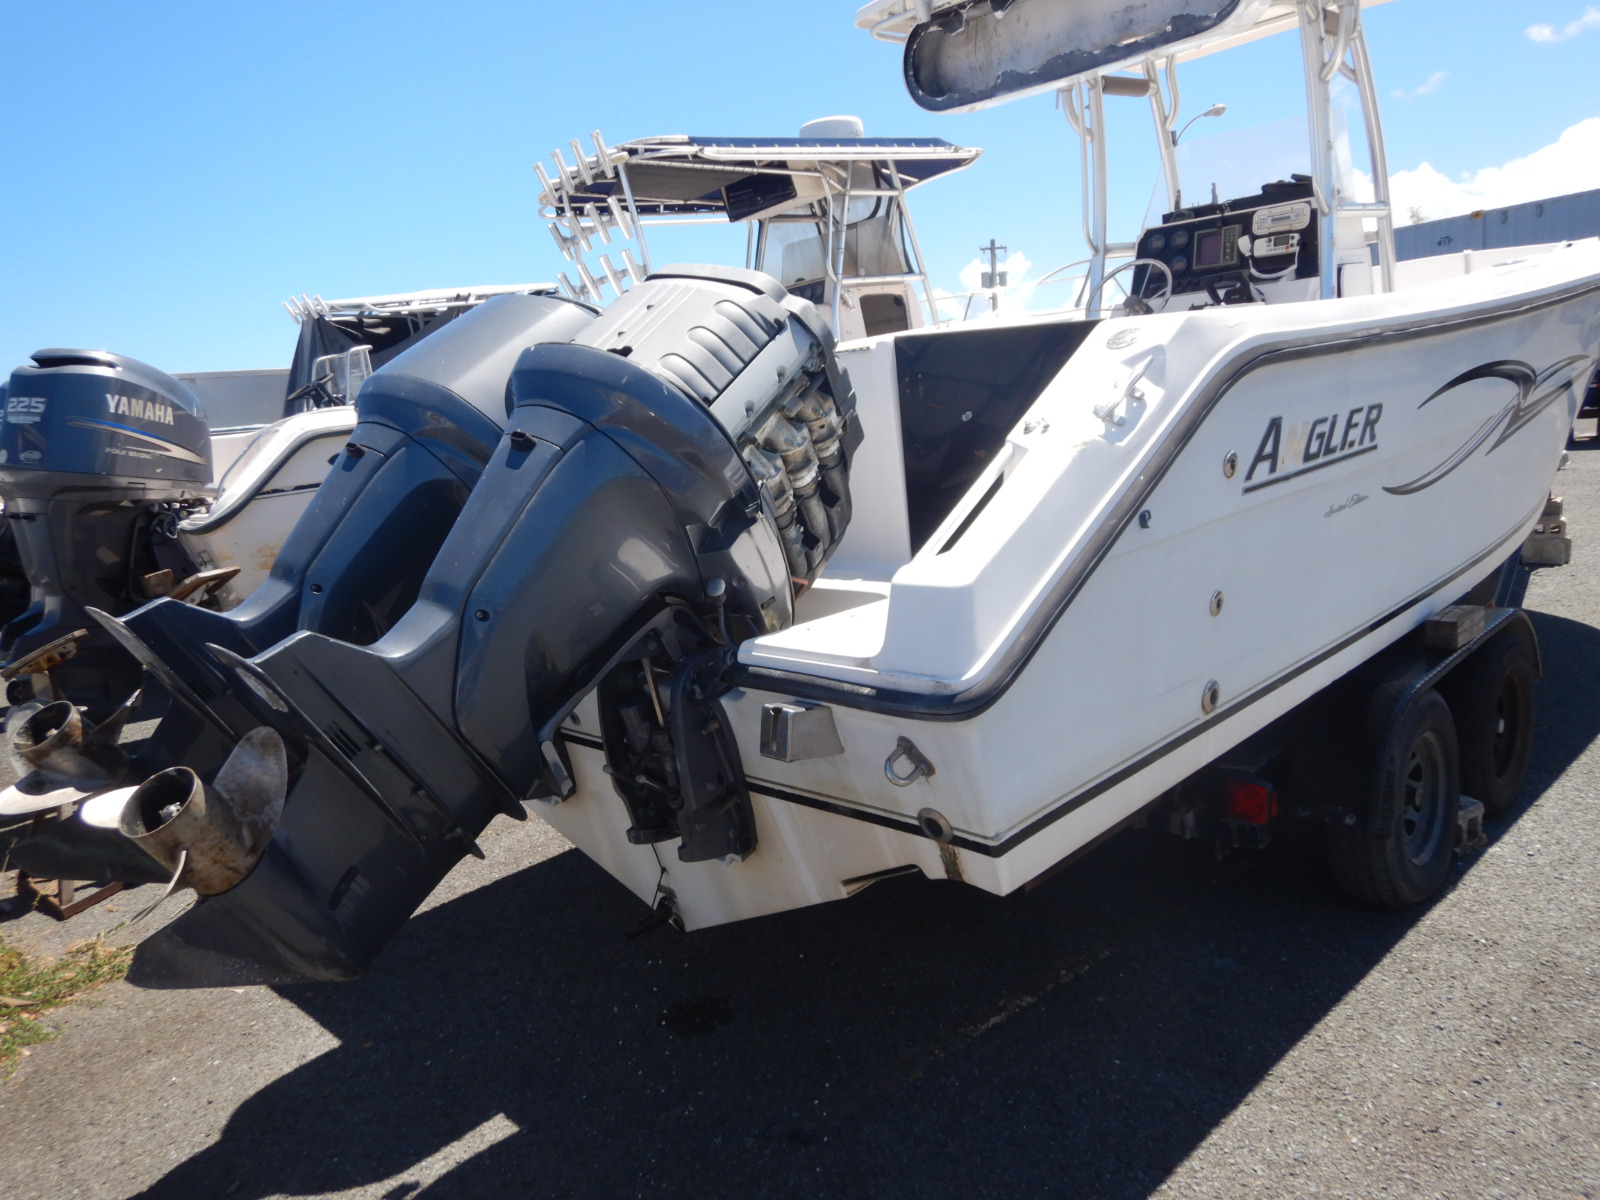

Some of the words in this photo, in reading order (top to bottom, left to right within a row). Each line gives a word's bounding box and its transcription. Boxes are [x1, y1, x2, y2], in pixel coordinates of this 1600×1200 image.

[7, 397, 47, 413] 225
[106, 394, 174, 425] YAMAHA
[1244, 403, 1383, 482] ANGLER
